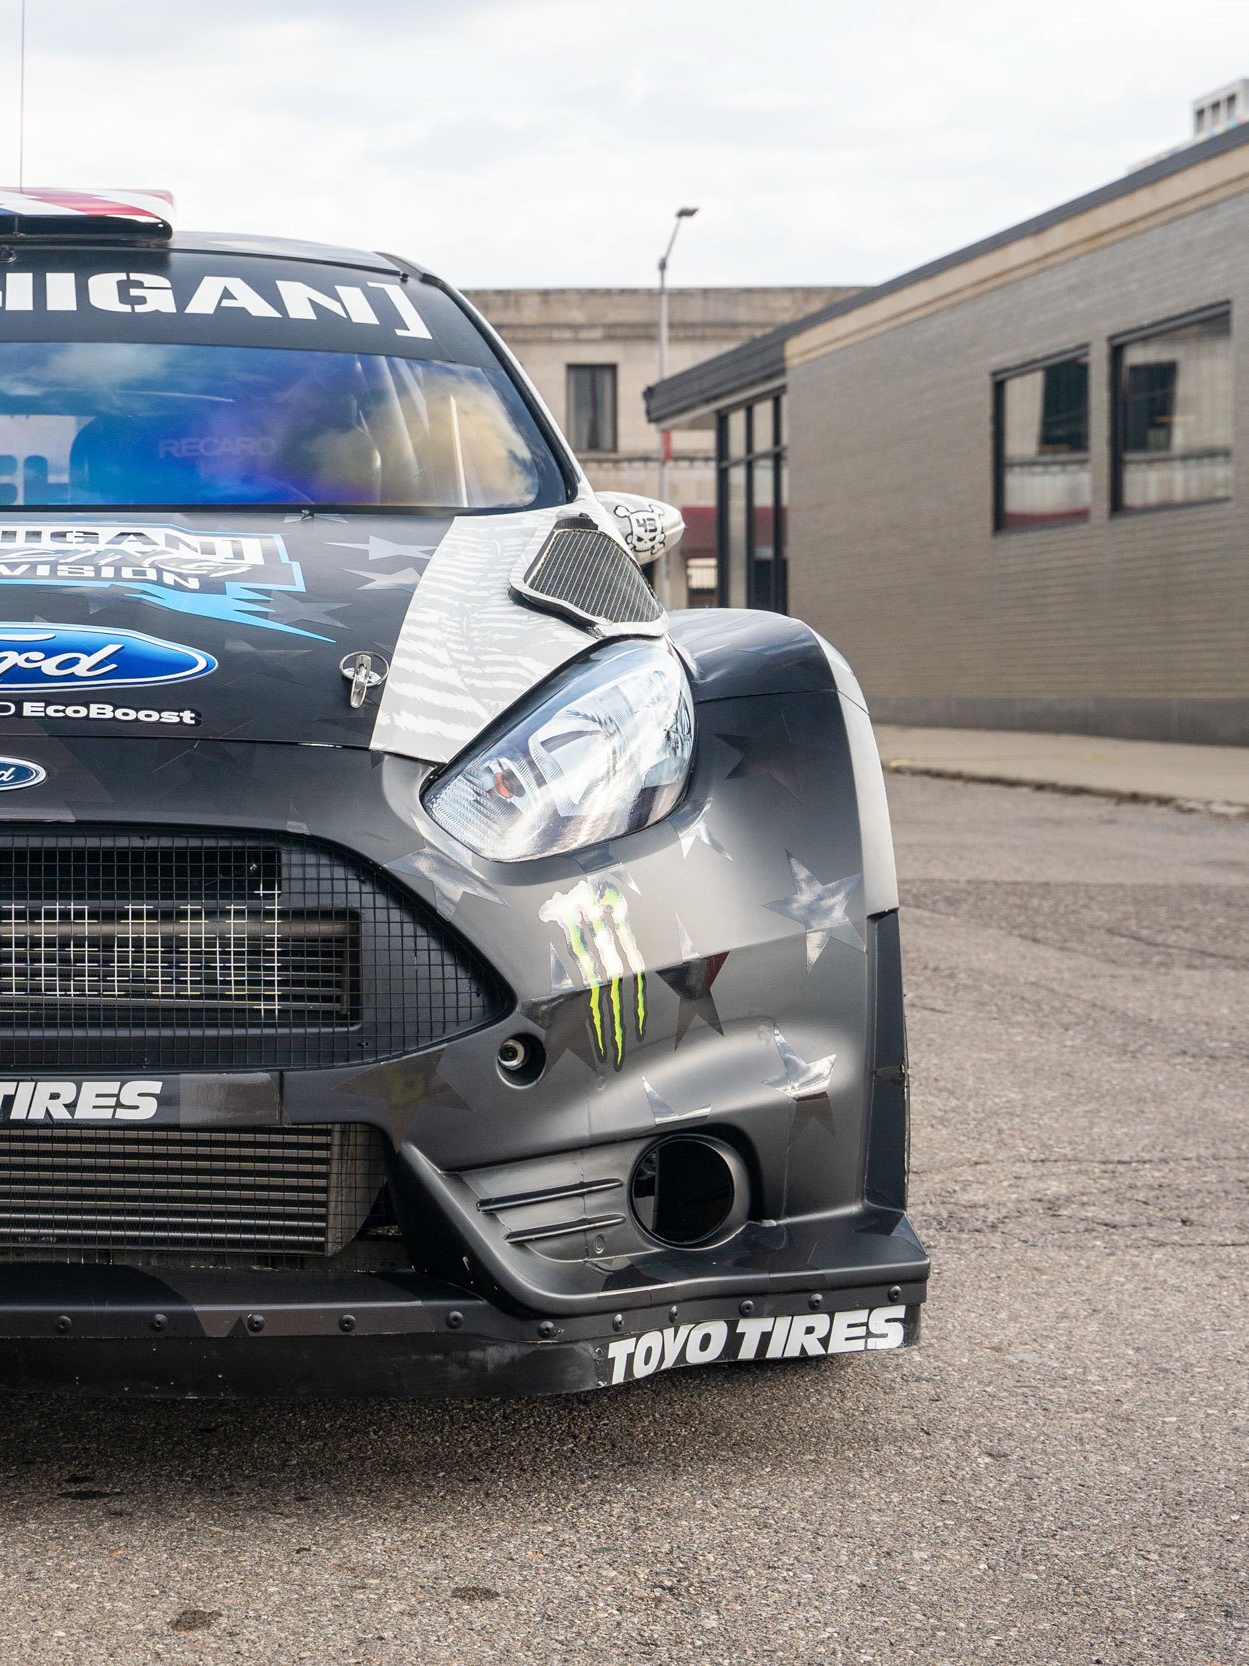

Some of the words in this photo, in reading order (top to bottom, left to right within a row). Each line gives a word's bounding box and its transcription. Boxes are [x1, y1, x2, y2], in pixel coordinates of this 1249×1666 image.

[157, 436, 278, 459] RECARO
[635, 517, 658, 533] 43
[22, 701, 196, 725] EcoBoost
[607, 1320, 729, 1385] TOYO
[736, 1304, 907, 1358] TIRES
